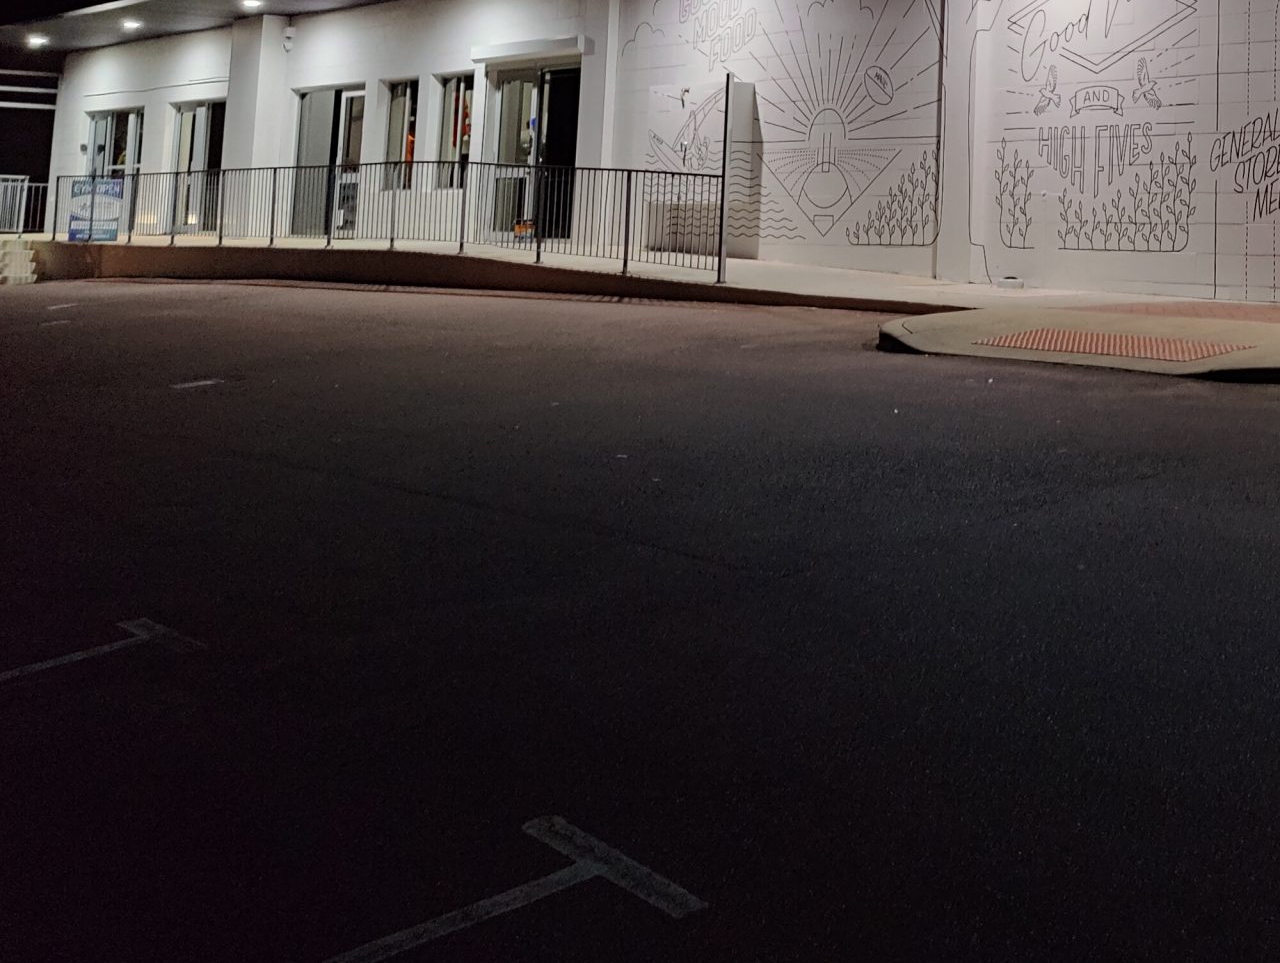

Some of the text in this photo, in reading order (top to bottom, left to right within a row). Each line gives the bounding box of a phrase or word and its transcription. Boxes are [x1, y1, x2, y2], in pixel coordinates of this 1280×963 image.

[708, 7, 758, 73] FOOD
[1083, 89, 1111, 105] AND
[1038, 121, 1153, 199] HIGH FIVES
